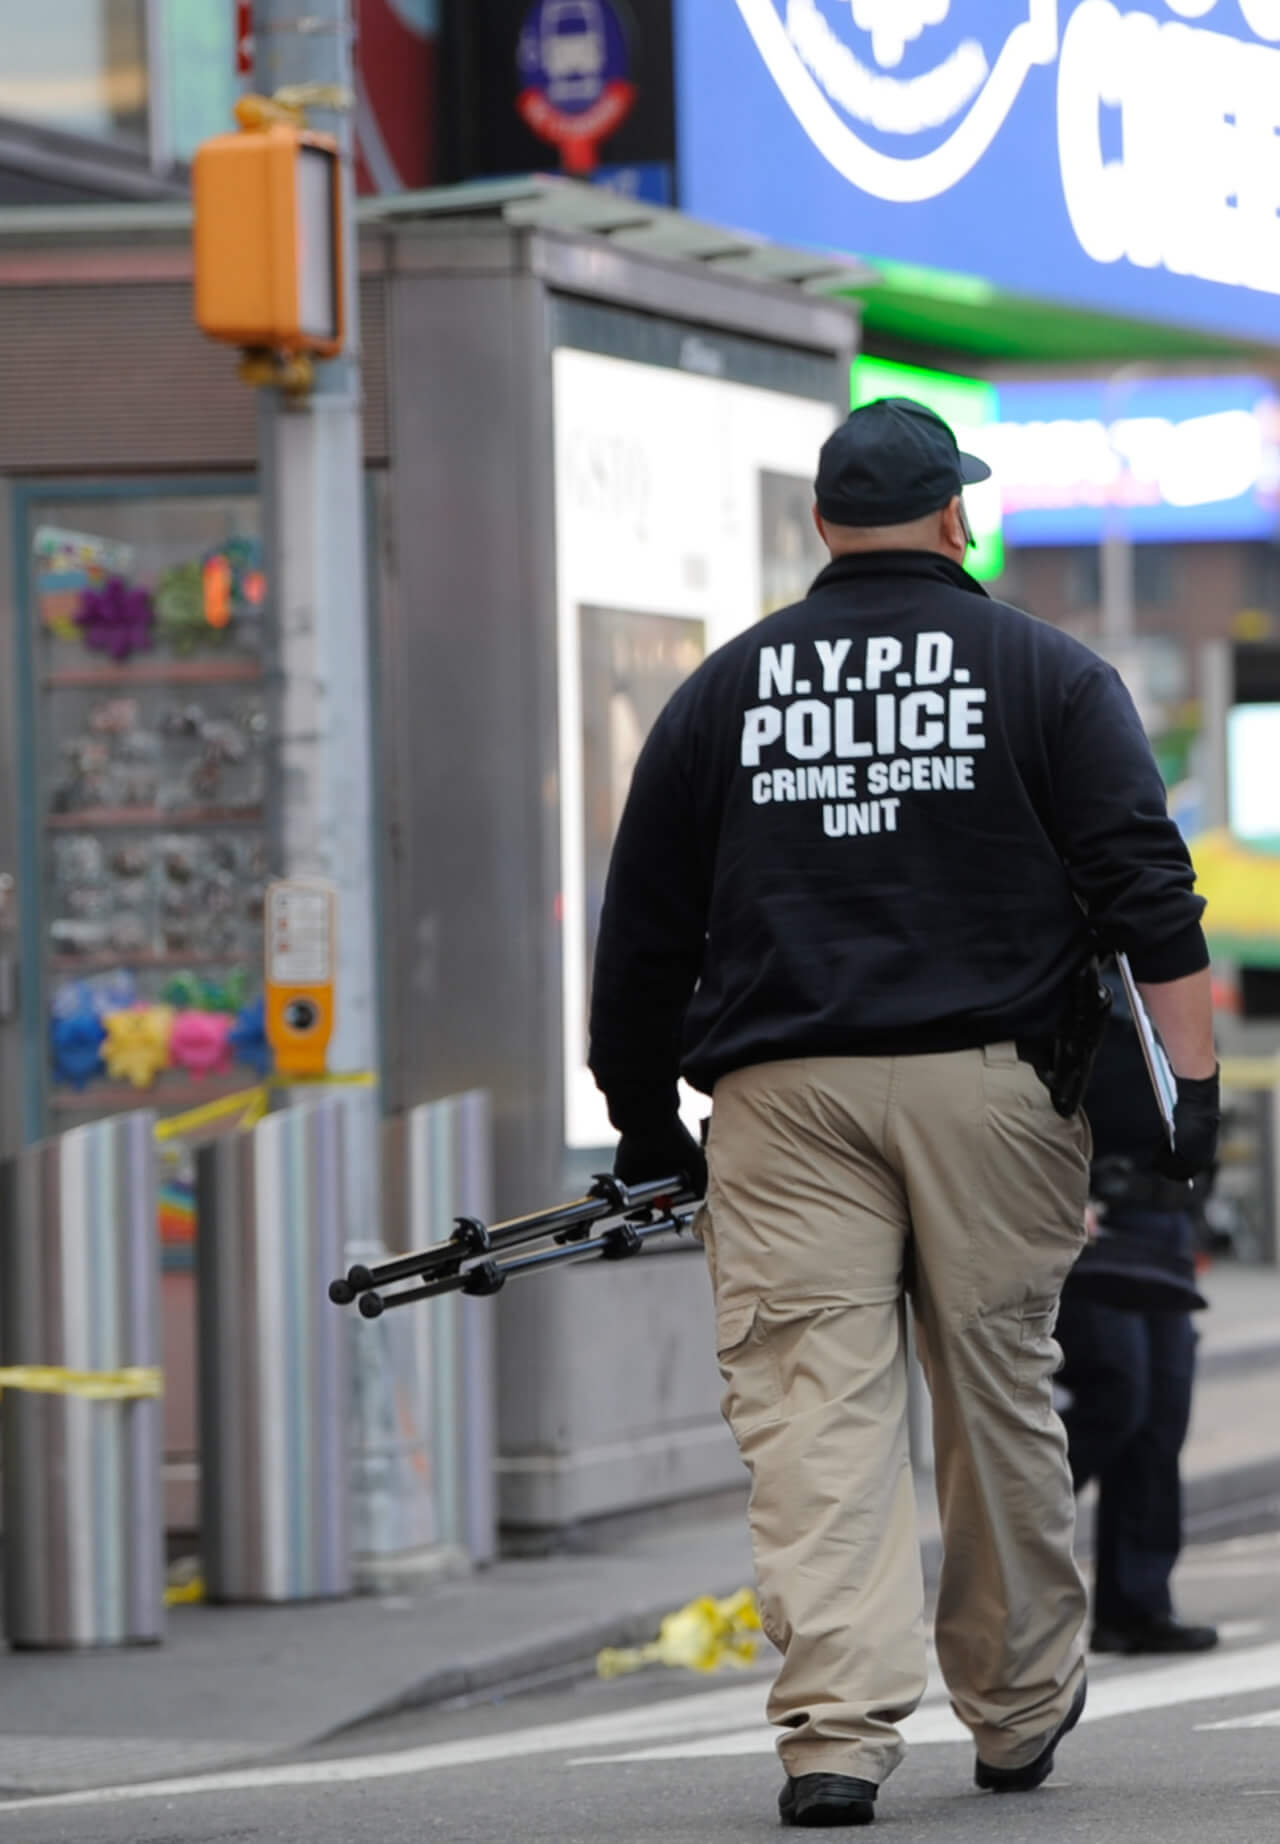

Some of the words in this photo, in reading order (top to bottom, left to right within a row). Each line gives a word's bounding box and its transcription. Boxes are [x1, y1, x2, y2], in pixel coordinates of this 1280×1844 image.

[758, 631, 971, 700] N.Y.P.D.
[741, 687, 987, 767] POLICE
[752, 764, 857, 805] CRIME
[867, 756, 976, 795] SCENE
[822, 797, 901, 838] UNIT
